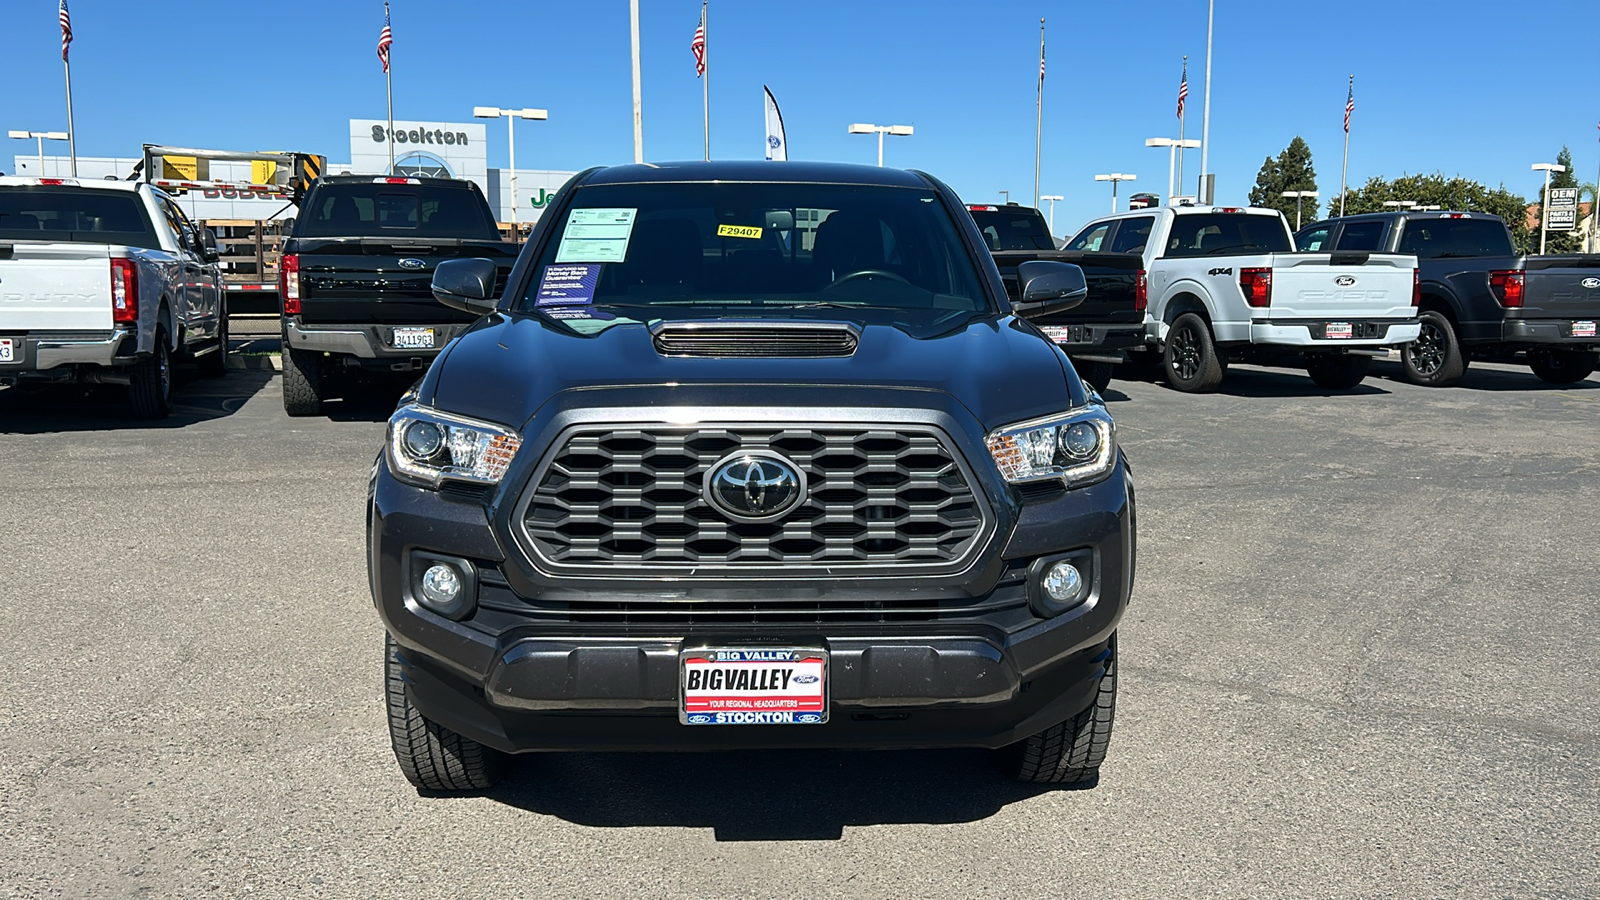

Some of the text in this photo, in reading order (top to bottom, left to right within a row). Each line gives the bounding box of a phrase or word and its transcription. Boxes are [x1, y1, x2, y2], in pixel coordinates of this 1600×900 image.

[371, 125, 468, 146] Stockton
[1551, 190, 1575, 198] OEM
[719, 226, 759, 236] F29407
[3, 293, 97, 302] DUTY
[1298, 290, 1389, 301] F-150
[717, 652, 793, 660] BIG VALLEY
[754, 700, 798, 708] HEADQUARTERS
[716, 712, 793, 723] STOCKTON
